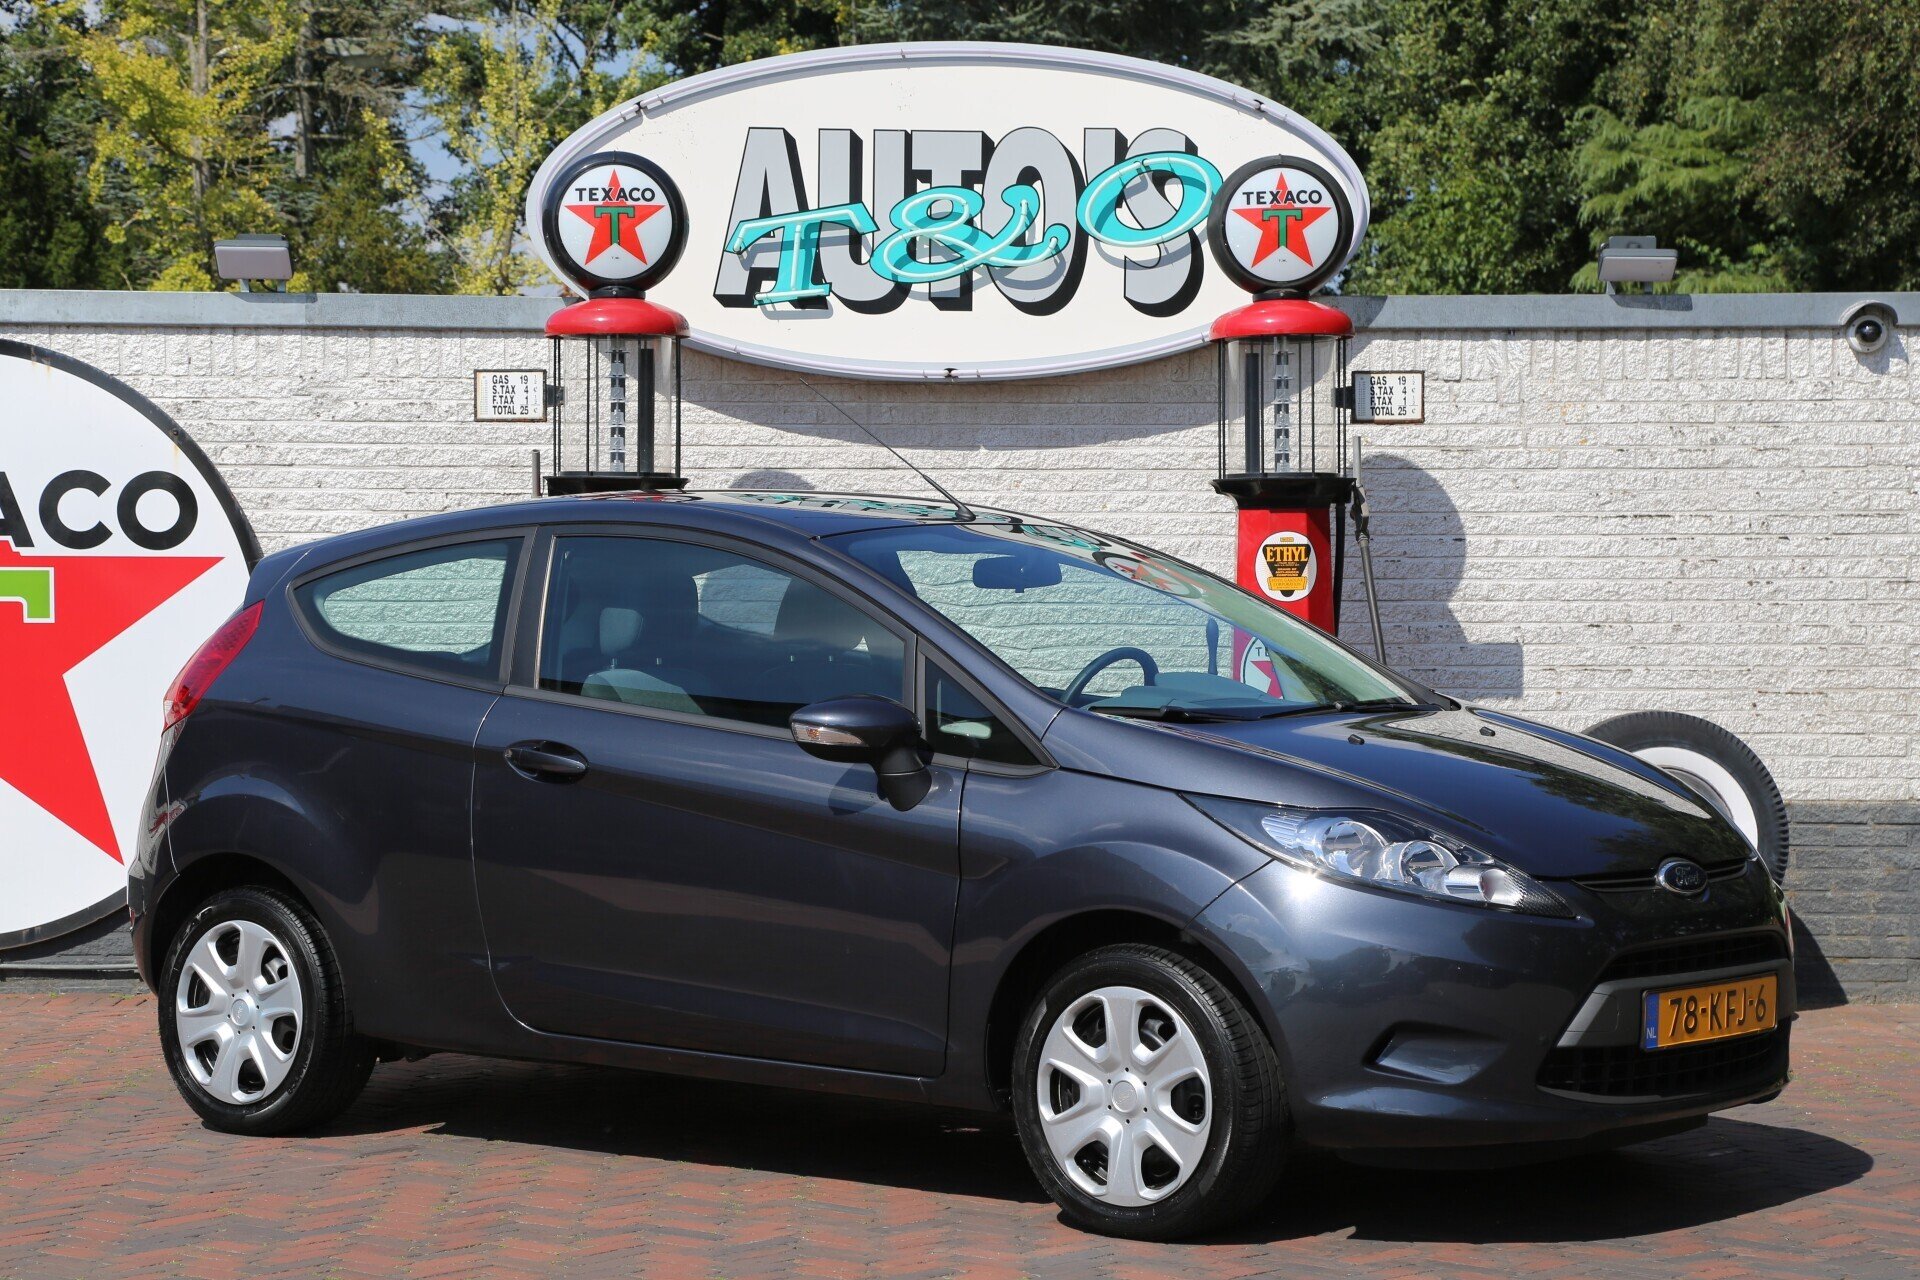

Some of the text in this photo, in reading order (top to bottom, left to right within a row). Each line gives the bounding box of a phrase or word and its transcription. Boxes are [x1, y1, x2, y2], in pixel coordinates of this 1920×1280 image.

[575, 187, 656, 202] TEXACO
[1242, 189, 1323, 205] TEXACO
[594, 205, 636, 246] T
[1262, 208, 1303, 248] T
[492, 374, 510, 385] GAS
[520, 374, 529, 385] 19
[1370, 375, 1387, 386] GAS
[1397, 375, 1407, 386] 19
[492, 385, 516, 395] S.TAX
[524, 385, 529, 394] 4
[1370, 385, 1394, 396] S.TAX
[1402, 386, 1407, 395] 4
[492, 395, 515, 405] F.TAX
[525, 395, 528, 404] 1
[1370, 396, 1393, 406] F.TAX
[1403, 396, 1406, 406] 1
[492, 405, 517, 415] TOTAL
[520, 405, 529, 415] 25
[1370, 406, 1394, 416] TOTAL
[1397, 406, 1407, 416] 25
[1265, 546, 1309, 562] ETHYL
[1668, 984, 1767, 1038] 78-KFJ-6
[1646, 1026, 1657, 1039] NL
